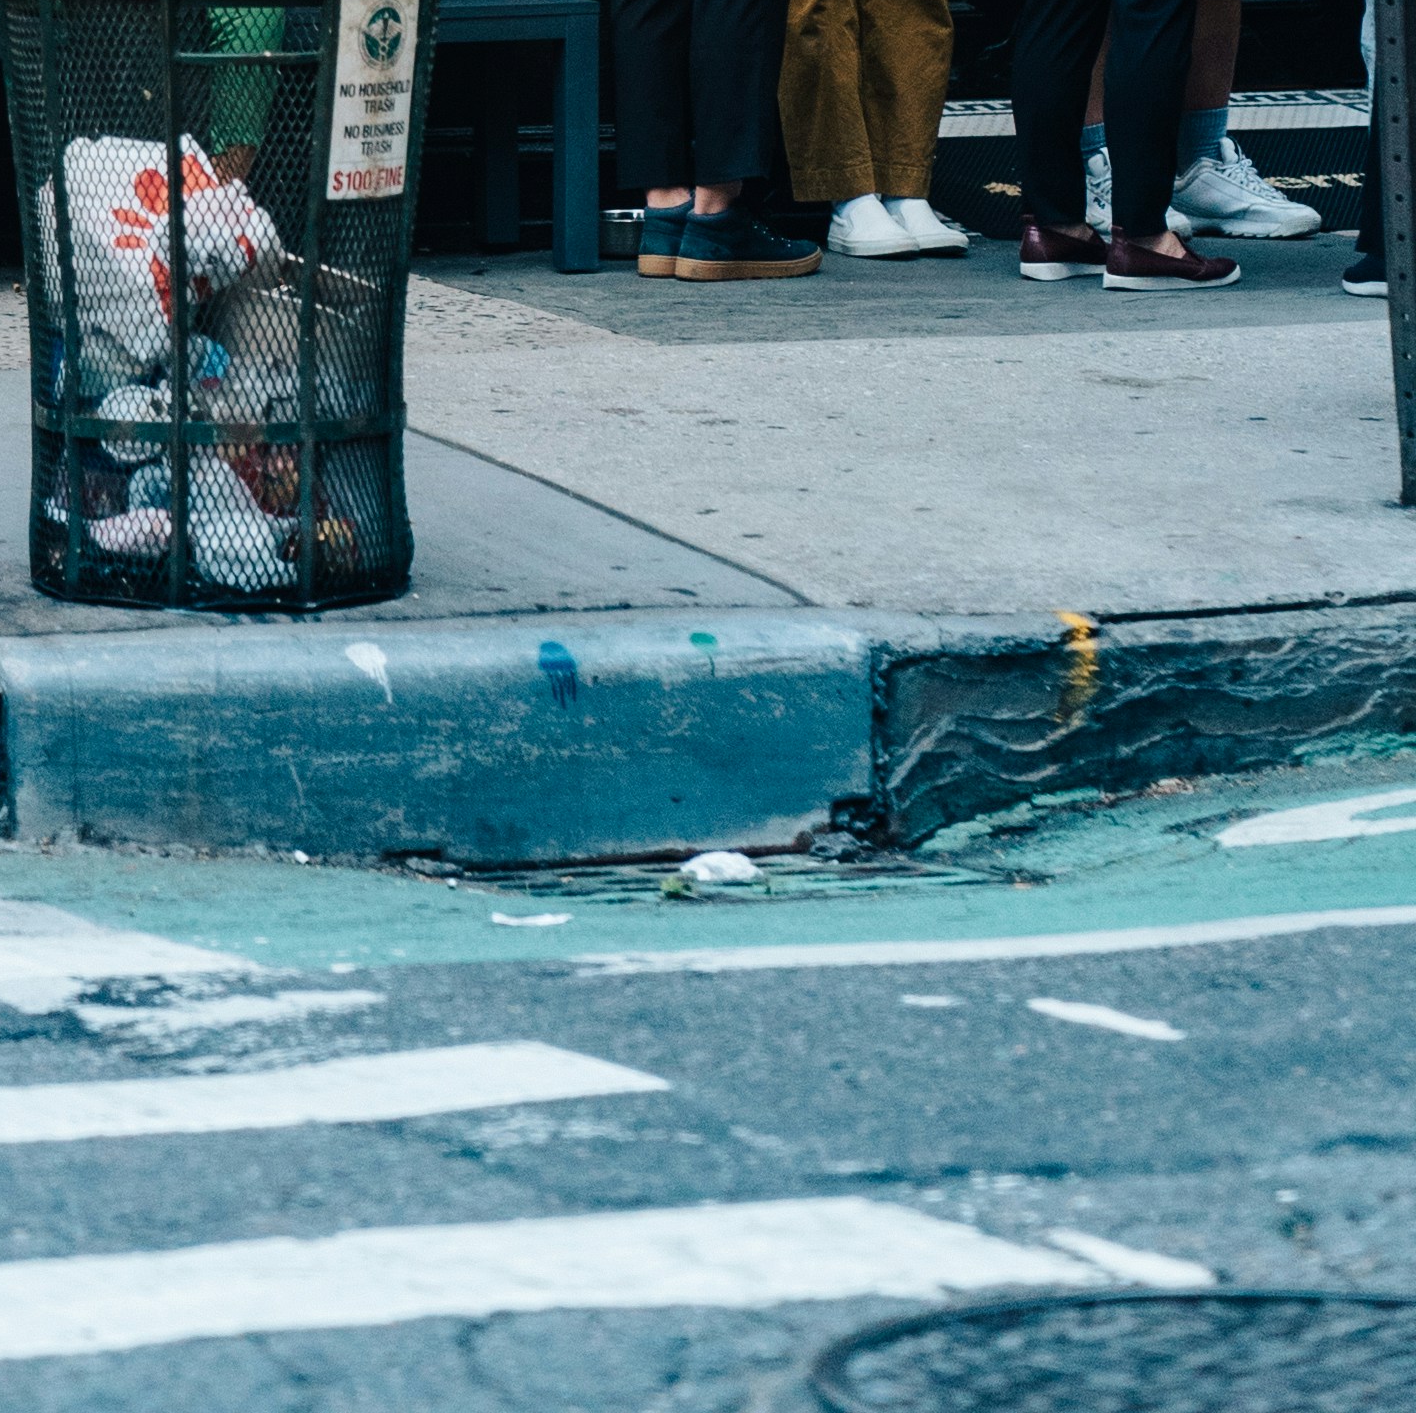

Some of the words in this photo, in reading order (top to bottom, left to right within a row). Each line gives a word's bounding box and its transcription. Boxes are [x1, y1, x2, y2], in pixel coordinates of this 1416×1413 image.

[339, 83, 356, 98] NO
[359, 79, 410, 97] HOUSEHOLD
[364, 98, 396, 114] TRASH
[344, 125, 360, 139] NO
[362, 120, 404, 139] BUSINESS
[361, 139, 392, 157] TRASH
[333, 169, 372, 193] $100
[376, 166, 403, 190] FINE
